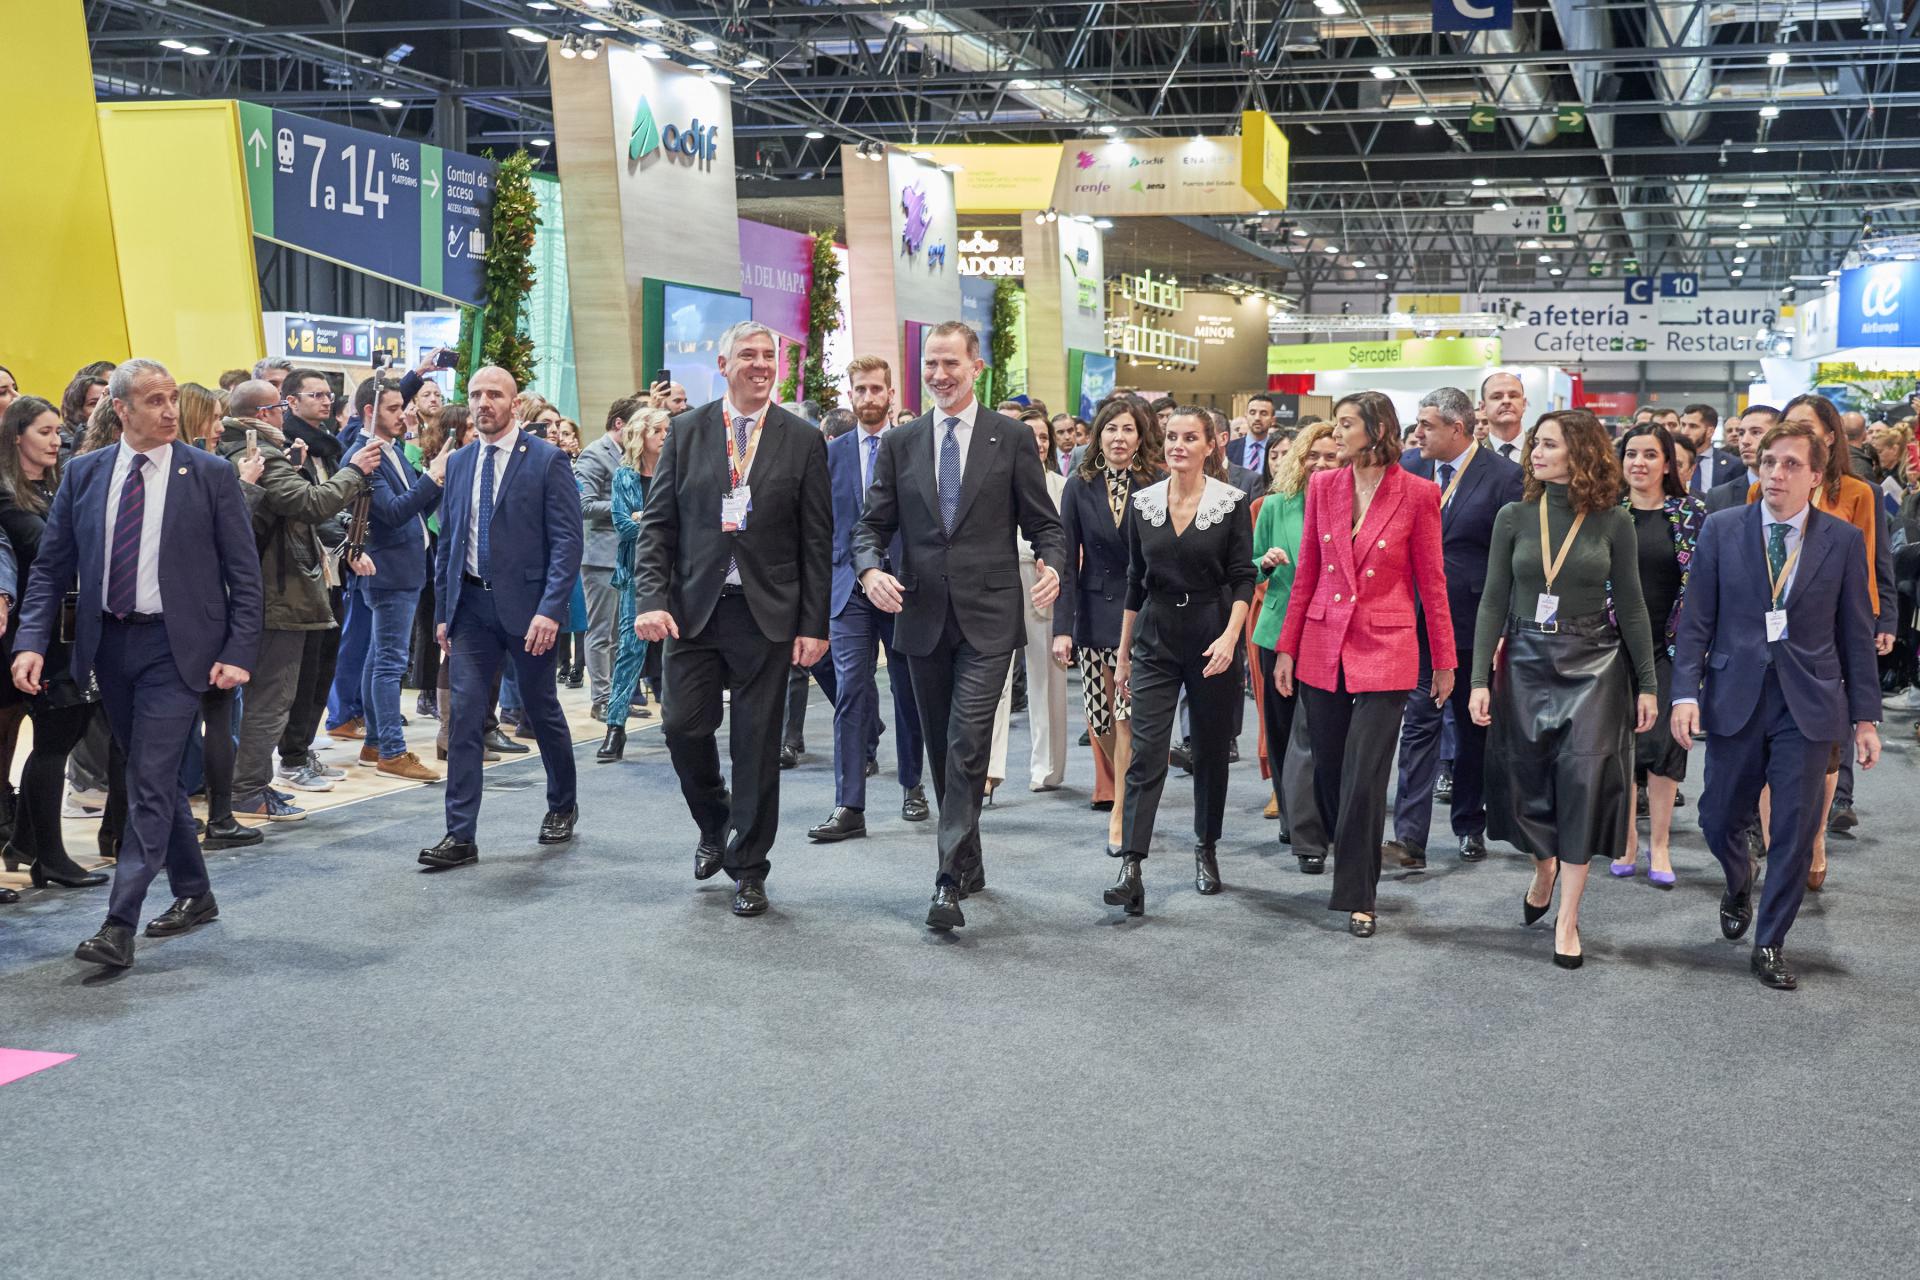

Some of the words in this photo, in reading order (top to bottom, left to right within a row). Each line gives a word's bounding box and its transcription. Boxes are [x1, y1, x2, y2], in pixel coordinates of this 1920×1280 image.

[662, 118, 718, 161] adif
[391, 152, 410, 172] Vías
[303, 134, 327, 208] 7
[324, 185, 336, 211] a
[341, 144, 390, 220] 14
[391, 173, 418, 188] PLATFORMS
[447, 164, 476, 186] Control
[477, 171, 488, 189] de
[447, 184, 474, 201] acceso
[1074, 180, 1111, 196] renfe
[447, 203, 462, 214] ACCESS
[462, 205, 481, 217] CONTROL
[754, 265, 776, 289] DEL
[776, 269, 806, 295] MAPA
[1672, 277, 1694, 295] 10
[1630, 279, 1648, 302] C
[1518, 304, 1629, 326] afetería
[1194, 325, 1236, 339] MINOR
[1534, 330, 1637, 352] Cafetea
[1349, 343, 1402, 363] Sercotel
